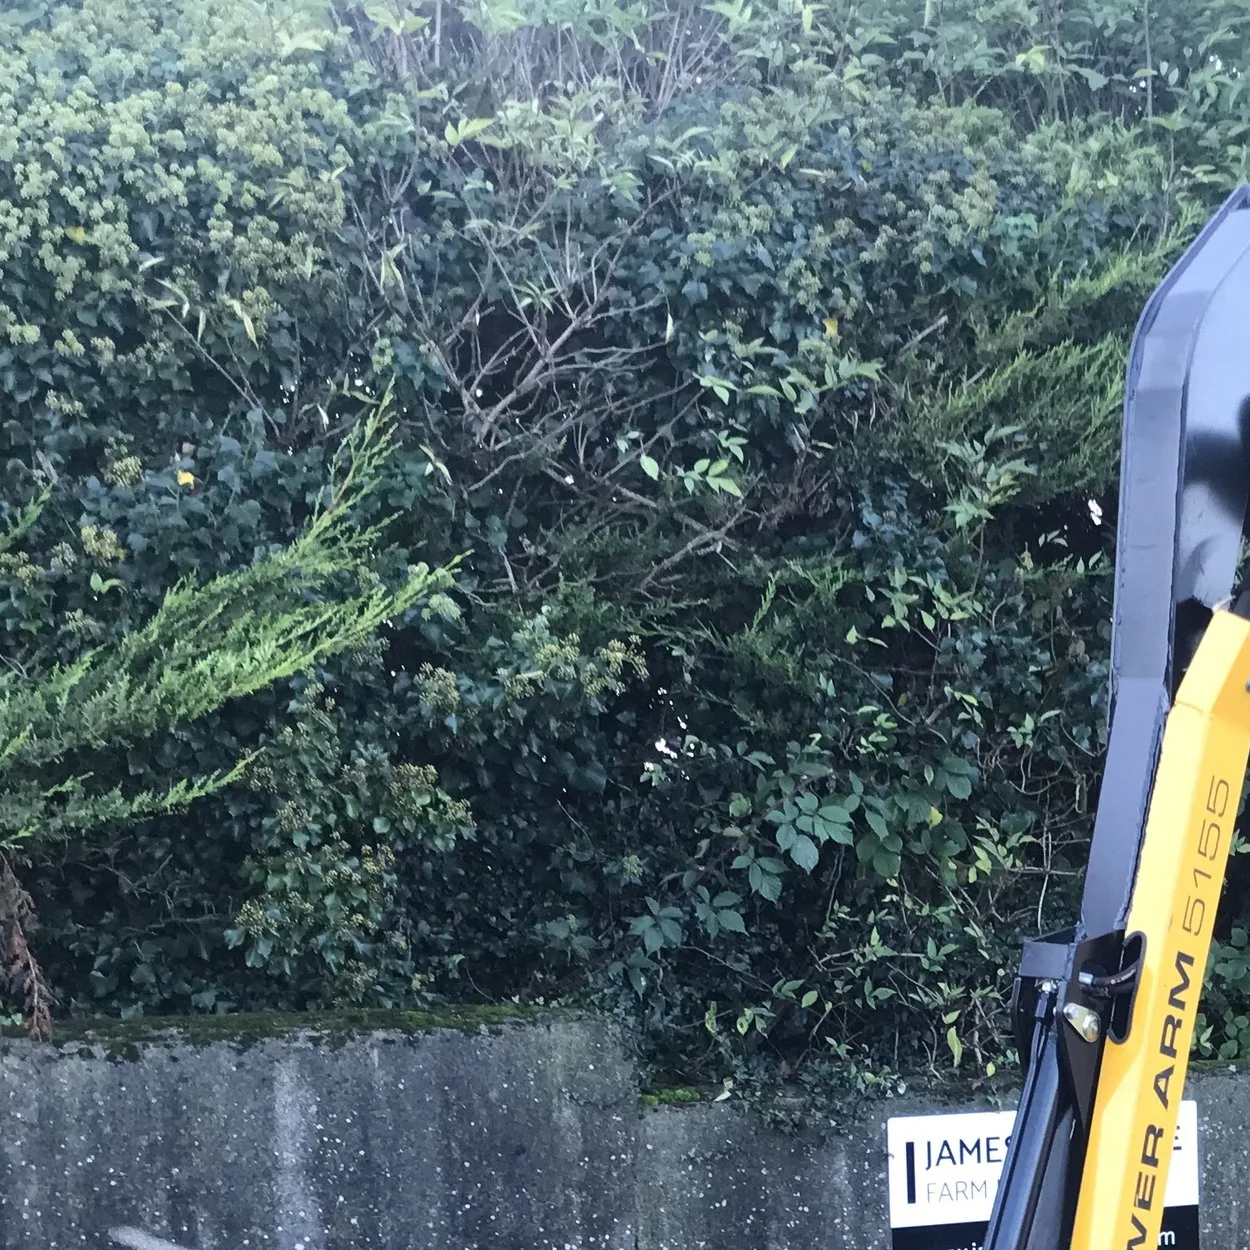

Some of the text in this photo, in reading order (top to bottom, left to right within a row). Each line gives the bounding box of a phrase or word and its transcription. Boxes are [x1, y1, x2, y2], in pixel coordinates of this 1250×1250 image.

[1153, 951, 1195, 1109] ARM
[1182, 775, 1230, 936] 5155
[926, 1180, 988, 1203] FARM
